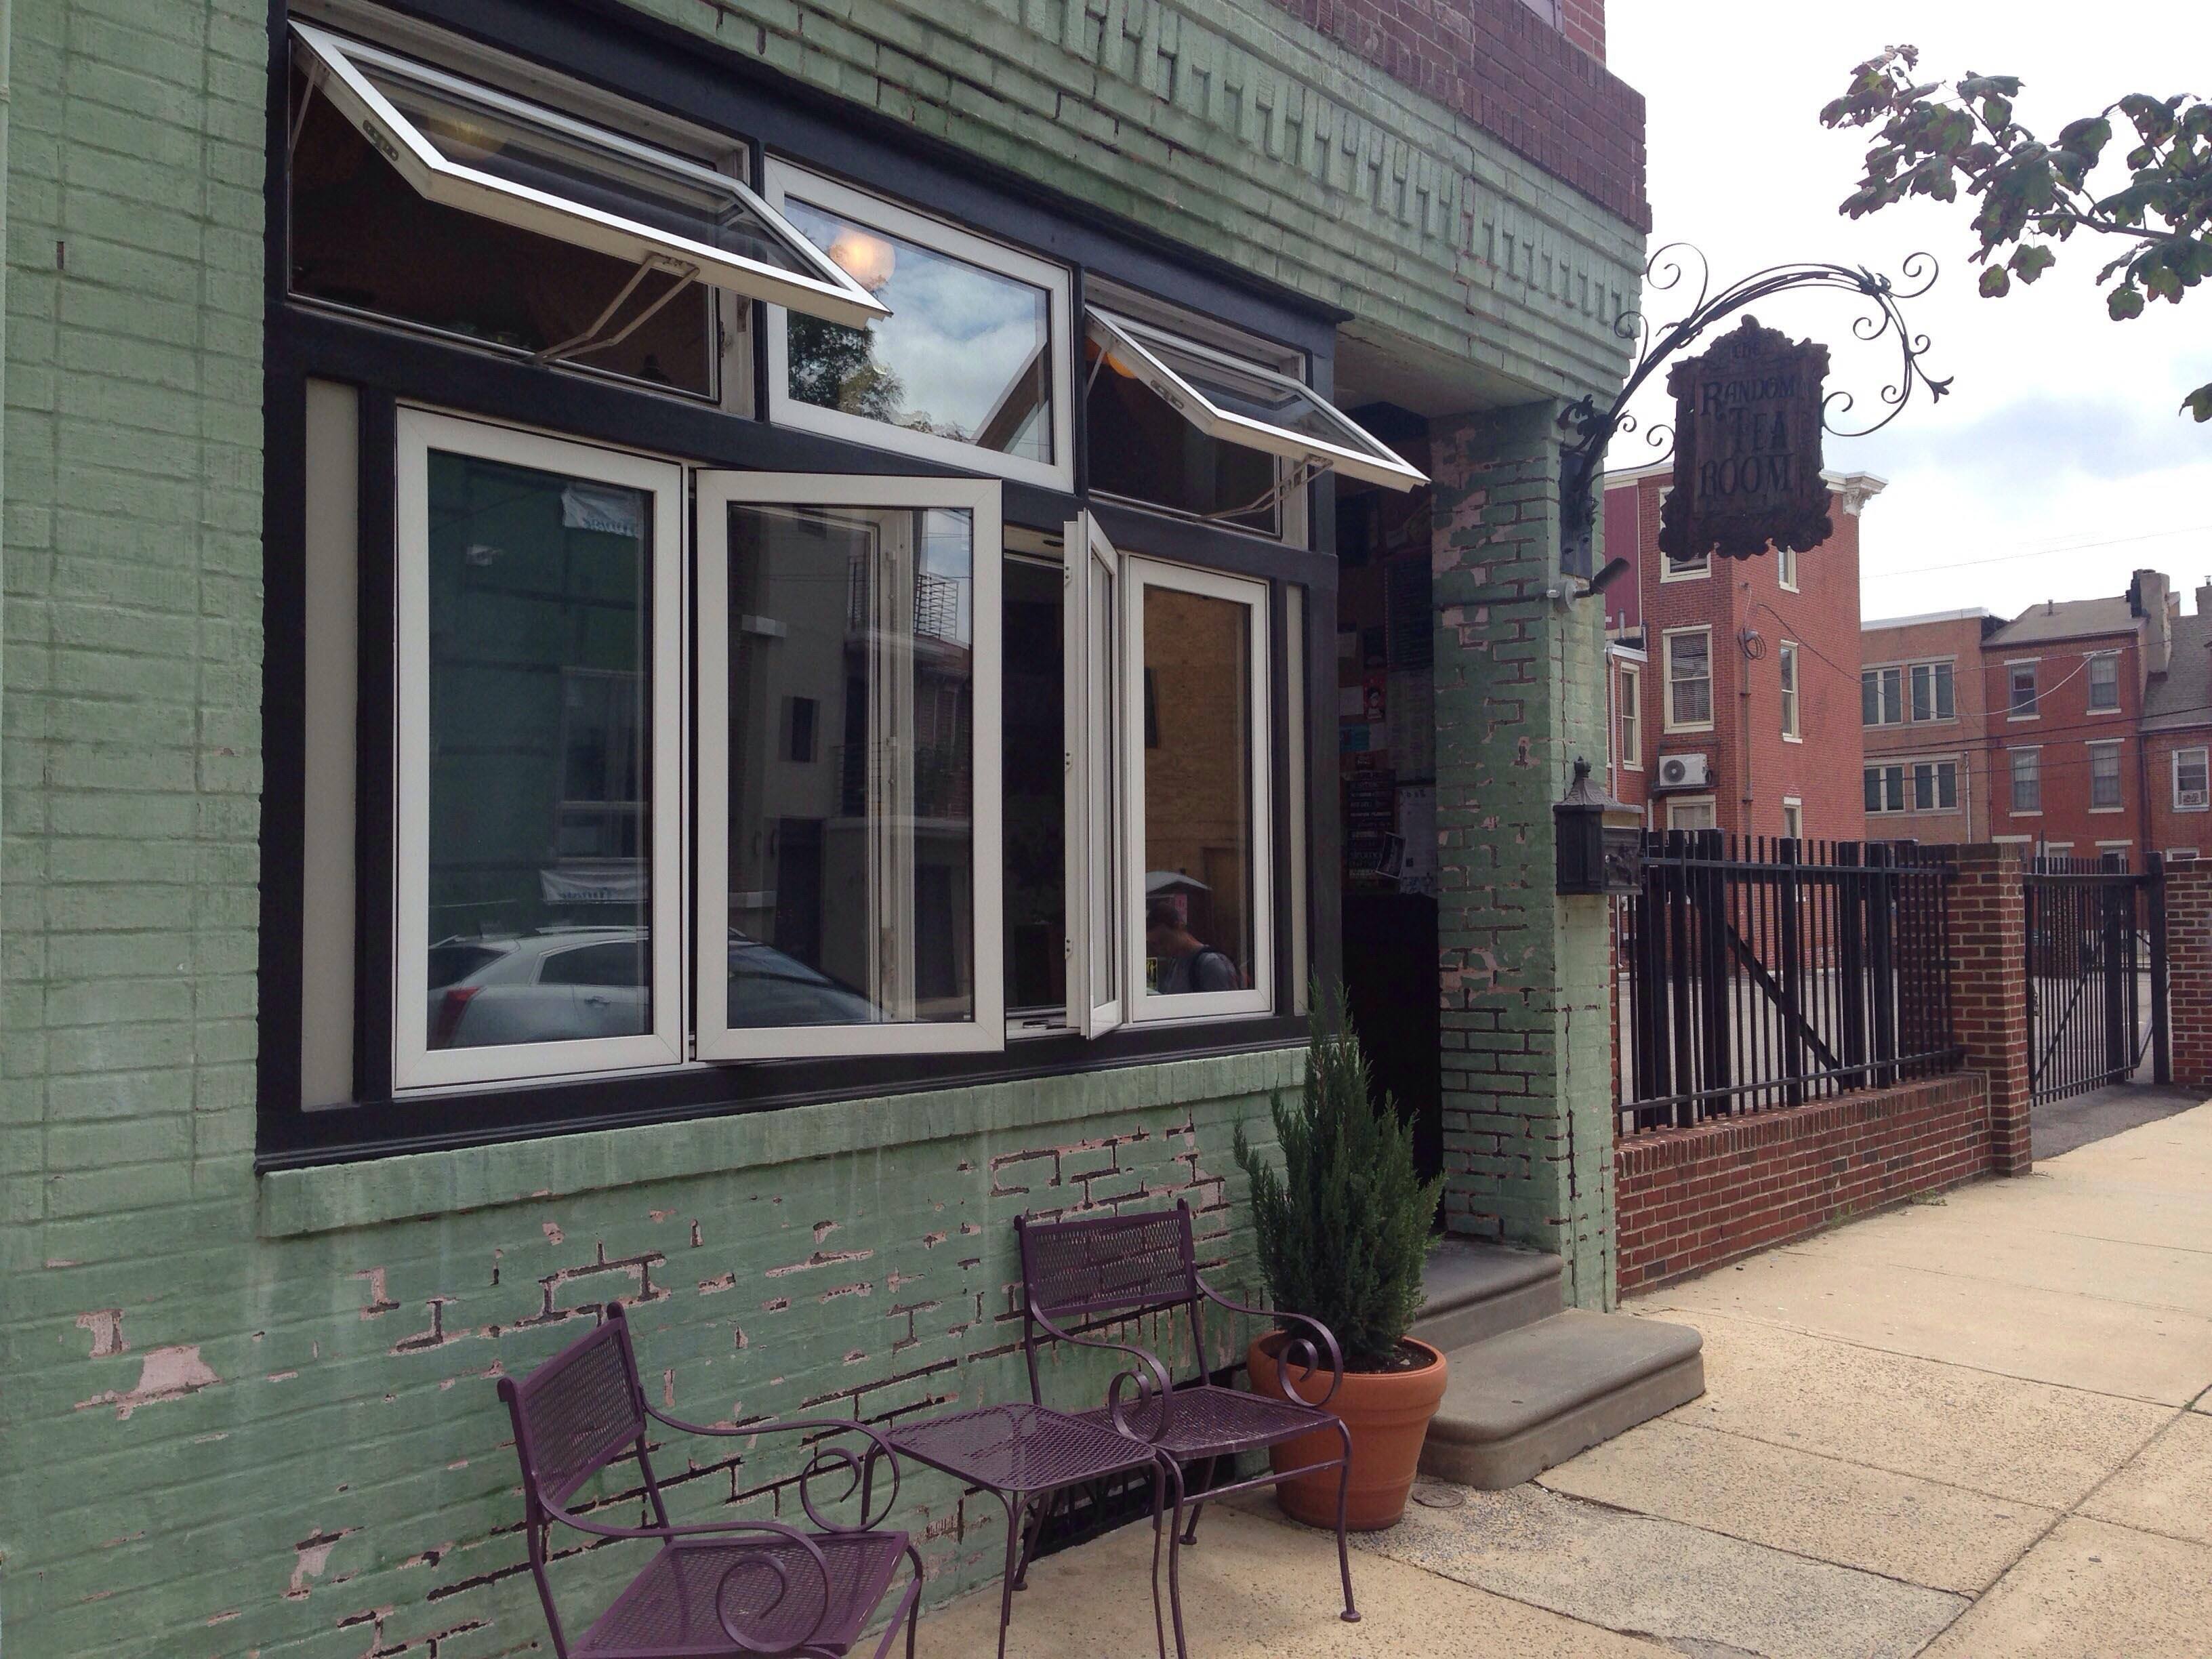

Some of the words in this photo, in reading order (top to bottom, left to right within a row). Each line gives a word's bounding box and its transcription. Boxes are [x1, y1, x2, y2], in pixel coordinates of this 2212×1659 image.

[1700, 375, 1795, 421] RANDOM
[1727, 407, 1787, 453] TEA
[1698, 453, 1795, 497] ROOM
